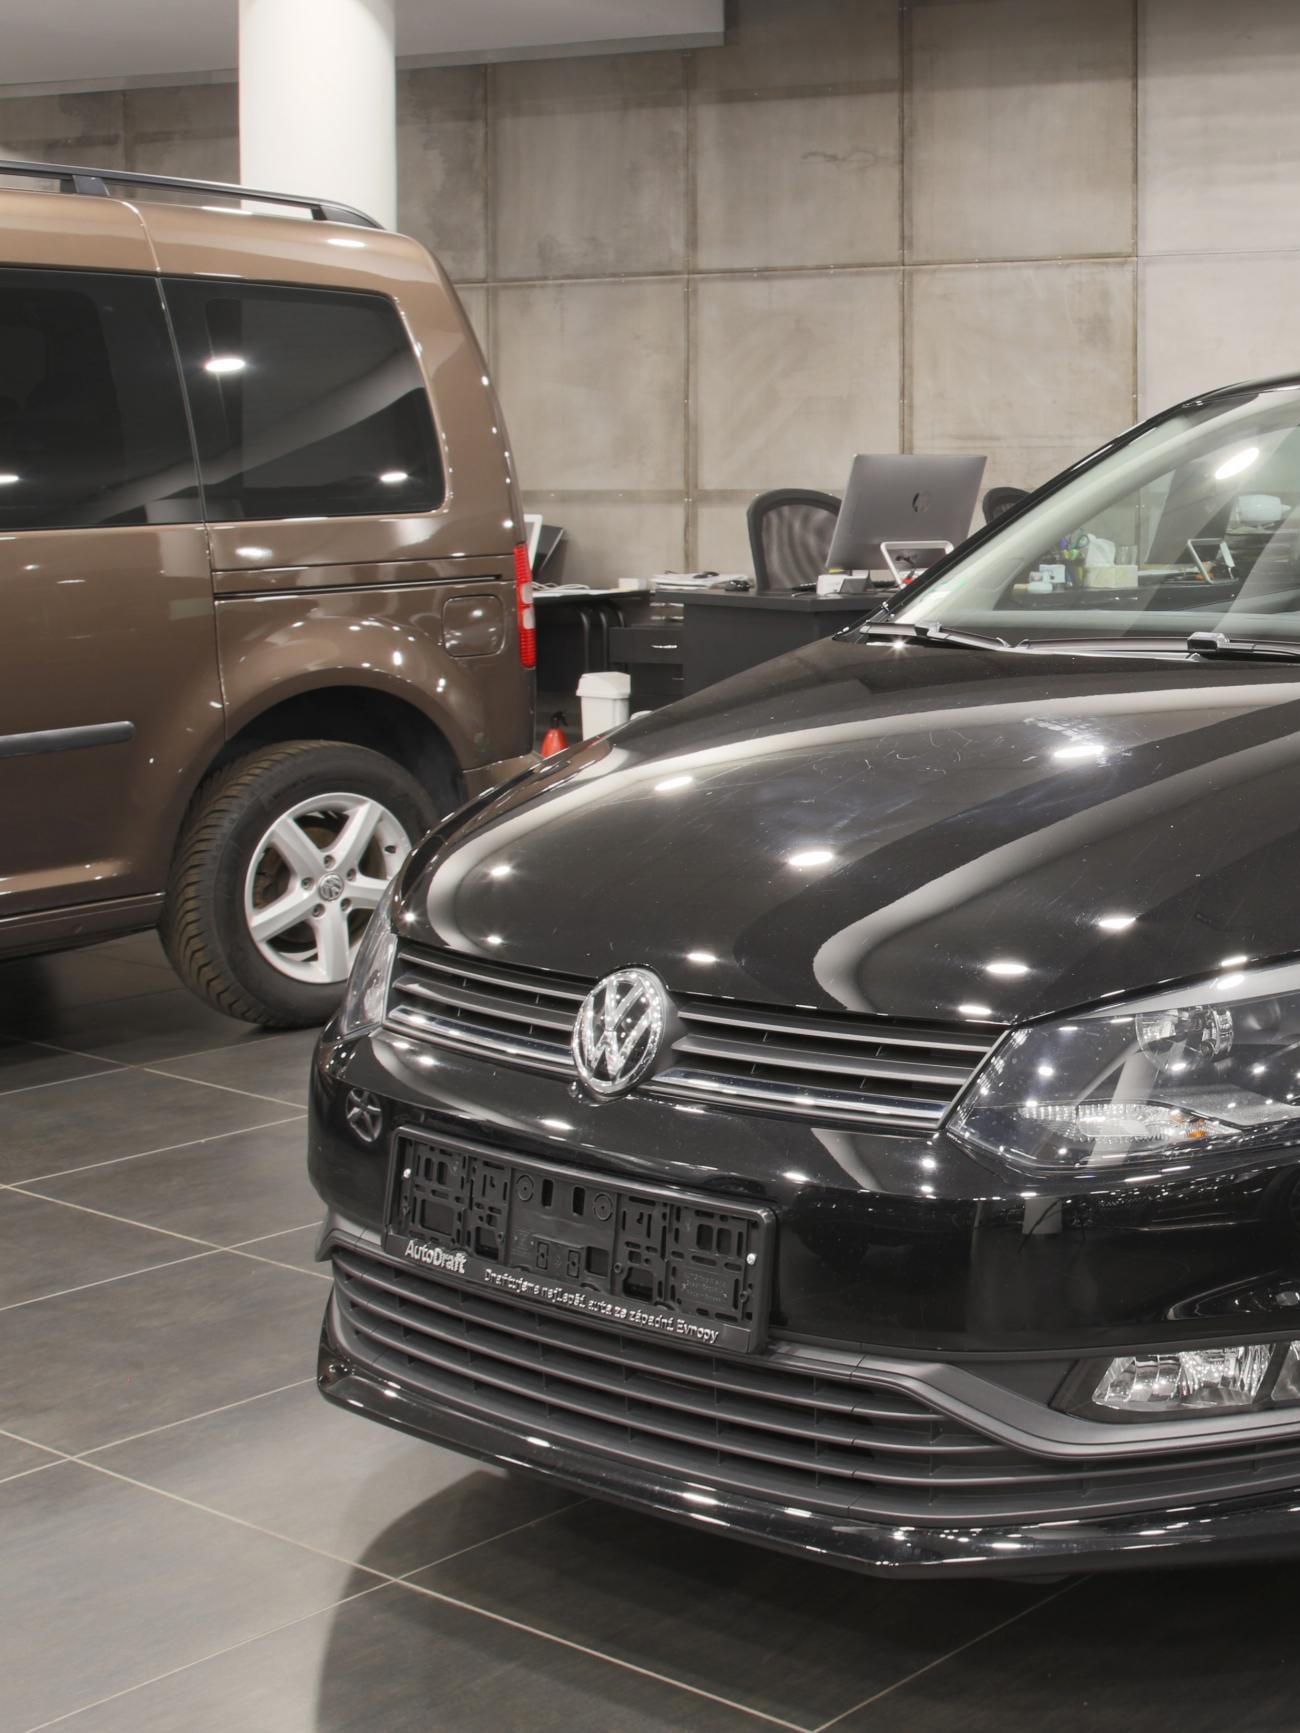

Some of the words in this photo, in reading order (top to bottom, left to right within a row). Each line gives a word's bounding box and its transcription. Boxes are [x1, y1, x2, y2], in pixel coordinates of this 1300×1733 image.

[573, 970, 662, 1093] VW
[404, 1239, 467, 1274] AutoDraft
[629, 1310, 674, 1331] západní
[676, 1319, 719, 1344] Evropy
